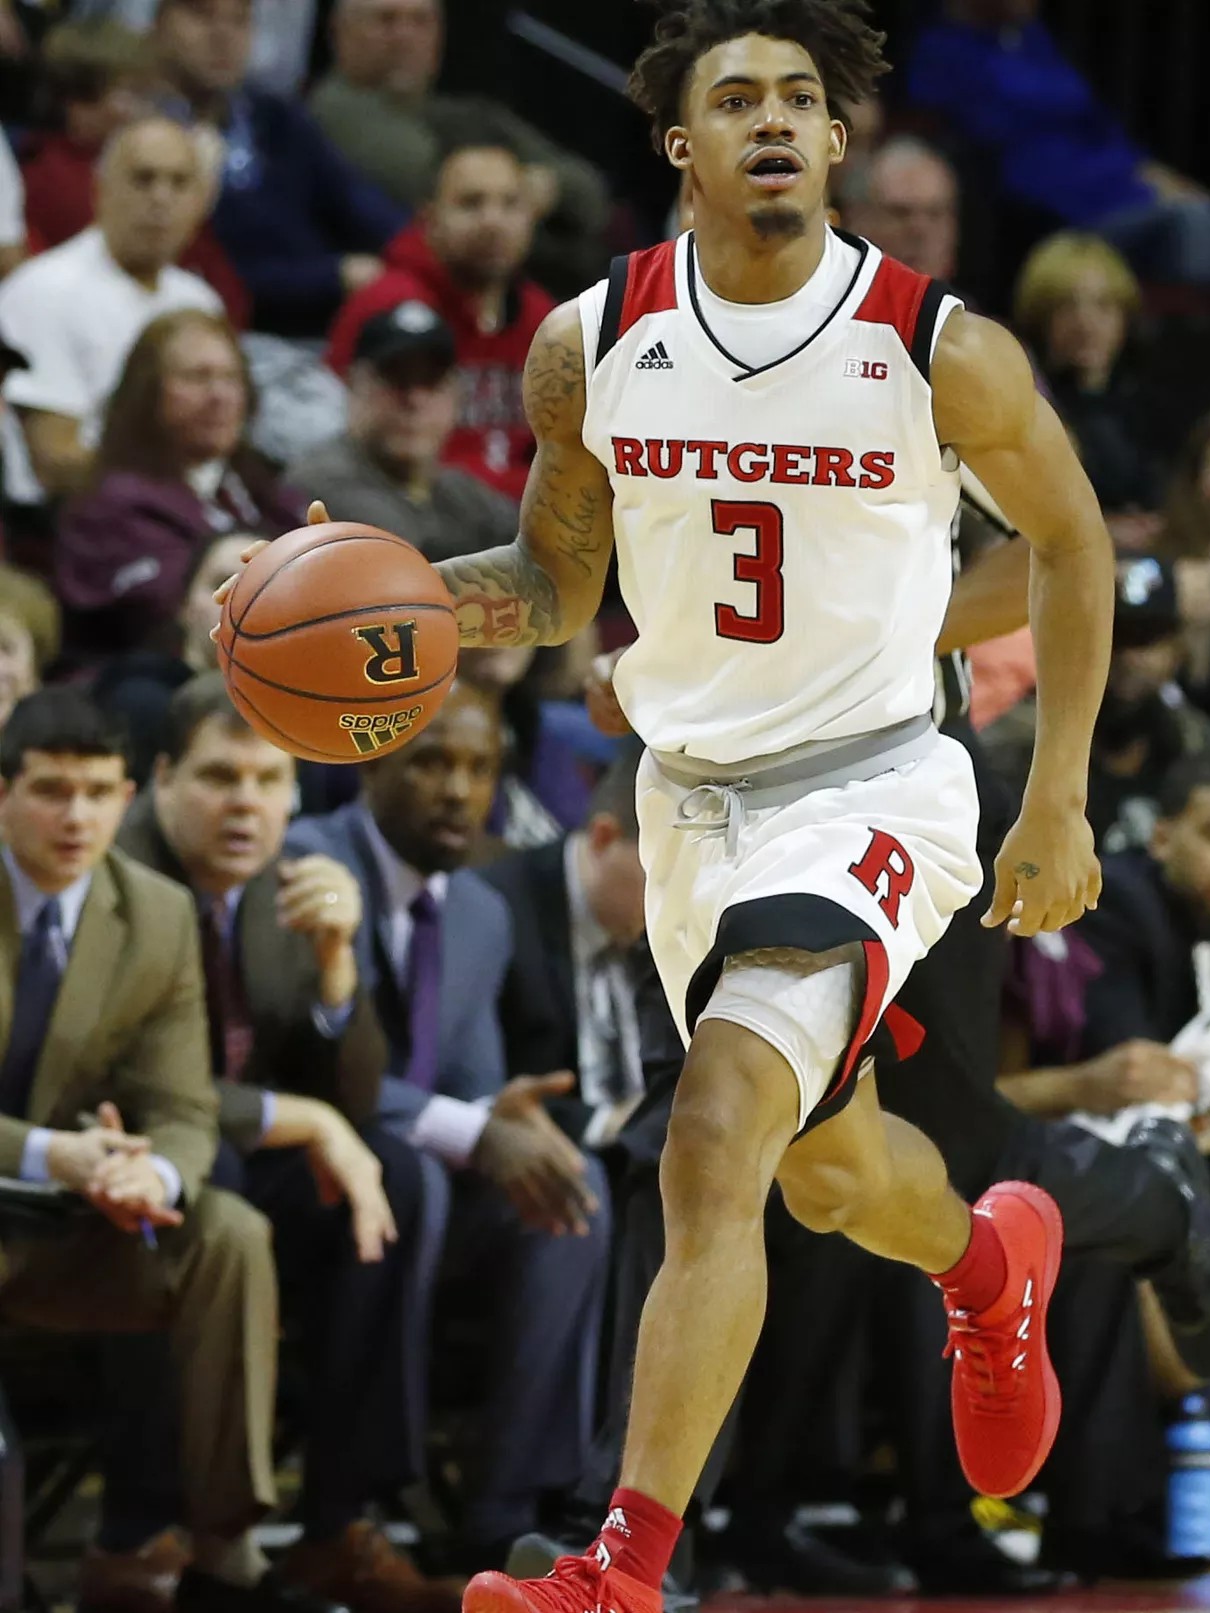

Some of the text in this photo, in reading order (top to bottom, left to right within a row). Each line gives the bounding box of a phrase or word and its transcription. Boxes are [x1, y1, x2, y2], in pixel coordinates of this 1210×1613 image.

[635, 357, 674, 370] adidas
[611, 436, 895, 490] RUTGERS
[710, 498, 784, 645] 3
[351, 618, 420, 685] R
[339, 704, 424, 731] adidas
[847, 826, 915, 931] R
